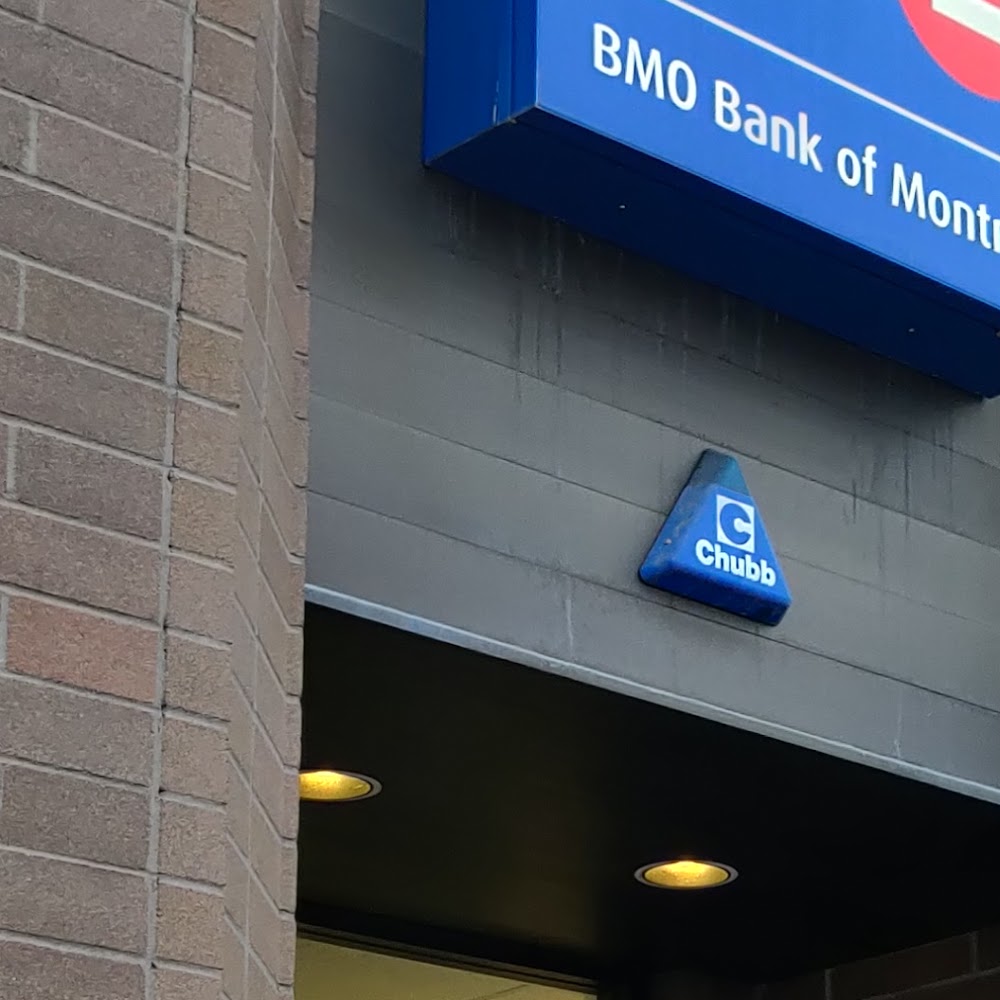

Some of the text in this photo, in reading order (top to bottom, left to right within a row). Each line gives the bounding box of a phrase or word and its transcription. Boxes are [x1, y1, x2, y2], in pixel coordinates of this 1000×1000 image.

[593, 23, 698, 111] BMO
[713, 79, 822, 172] Bank
[837, 146, 877, 195] of
